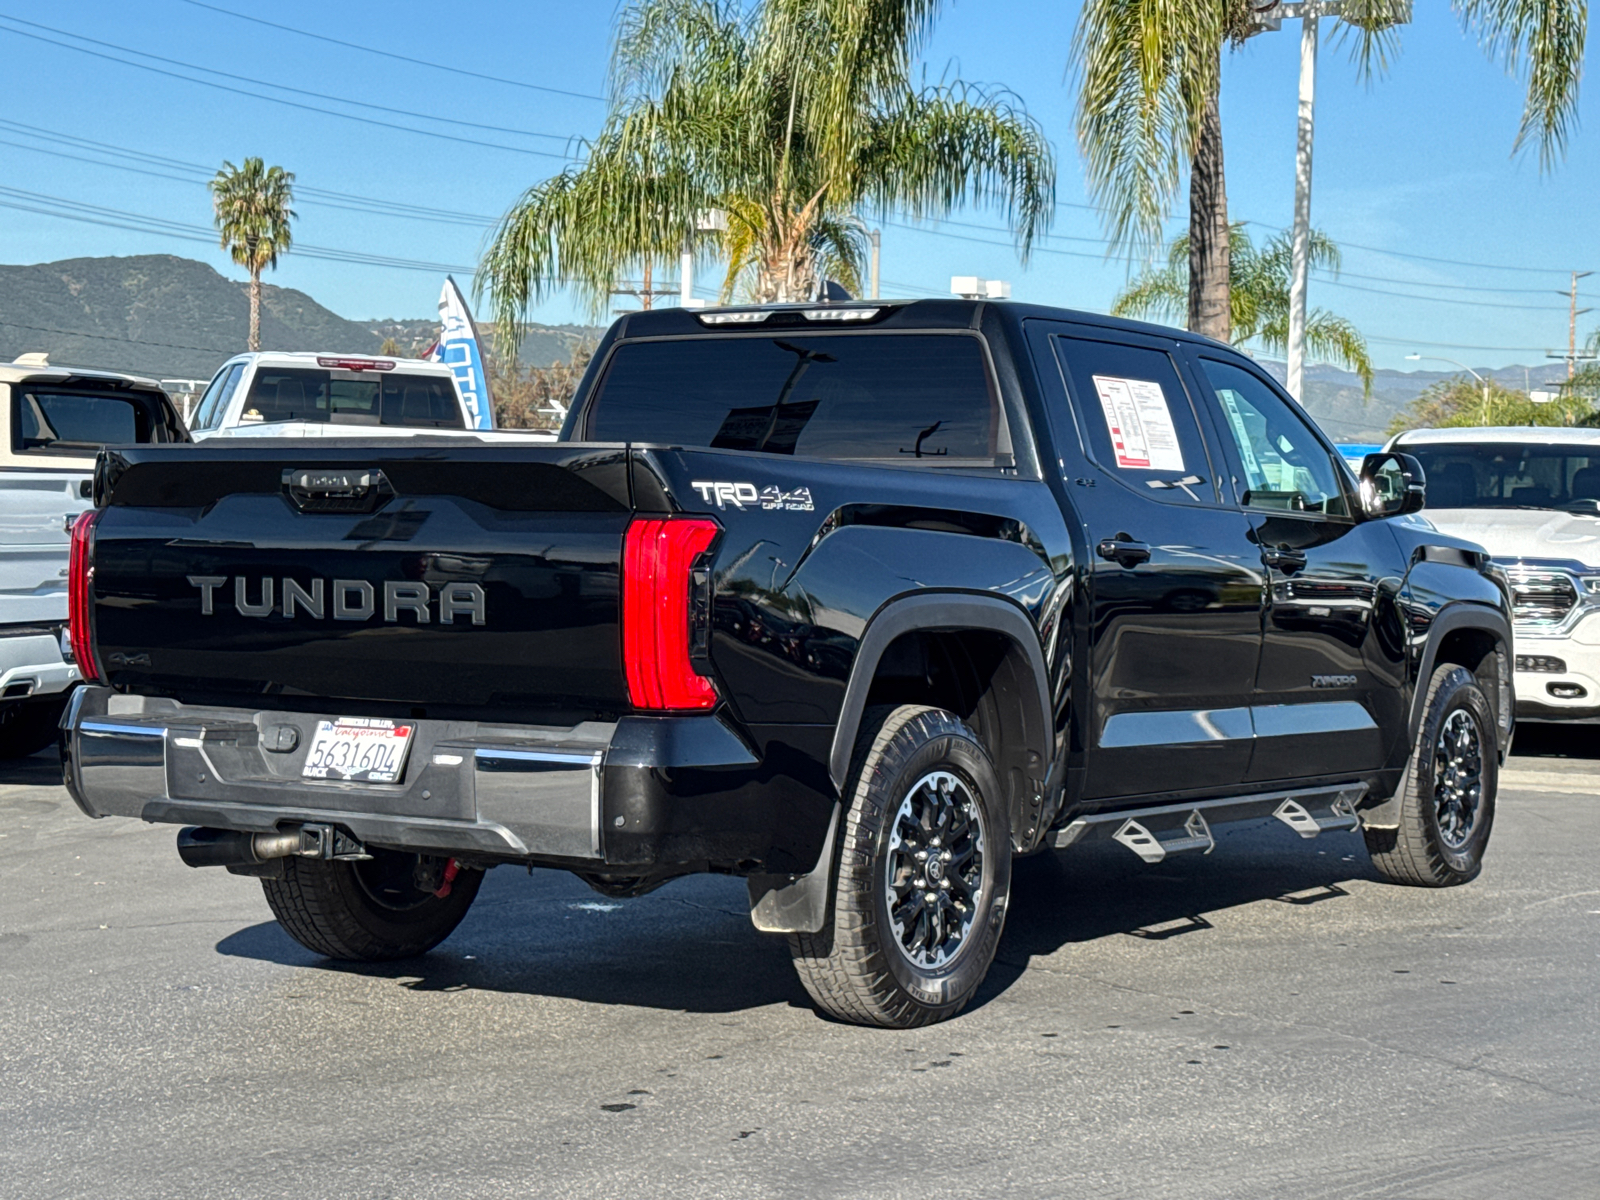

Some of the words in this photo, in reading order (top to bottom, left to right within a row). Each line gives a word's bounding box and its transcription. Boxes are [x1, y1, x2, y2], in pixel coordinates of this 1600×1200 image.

[691, 482, 760, 510] TRD
[762, 502, 784, 510] OFF
[186, 575, 486, 626] TUNDRA
[335, 727, 394, 741] California
[312, 740, 397, 771] 56316D4
[302, 766, 328, 777] BUICK
